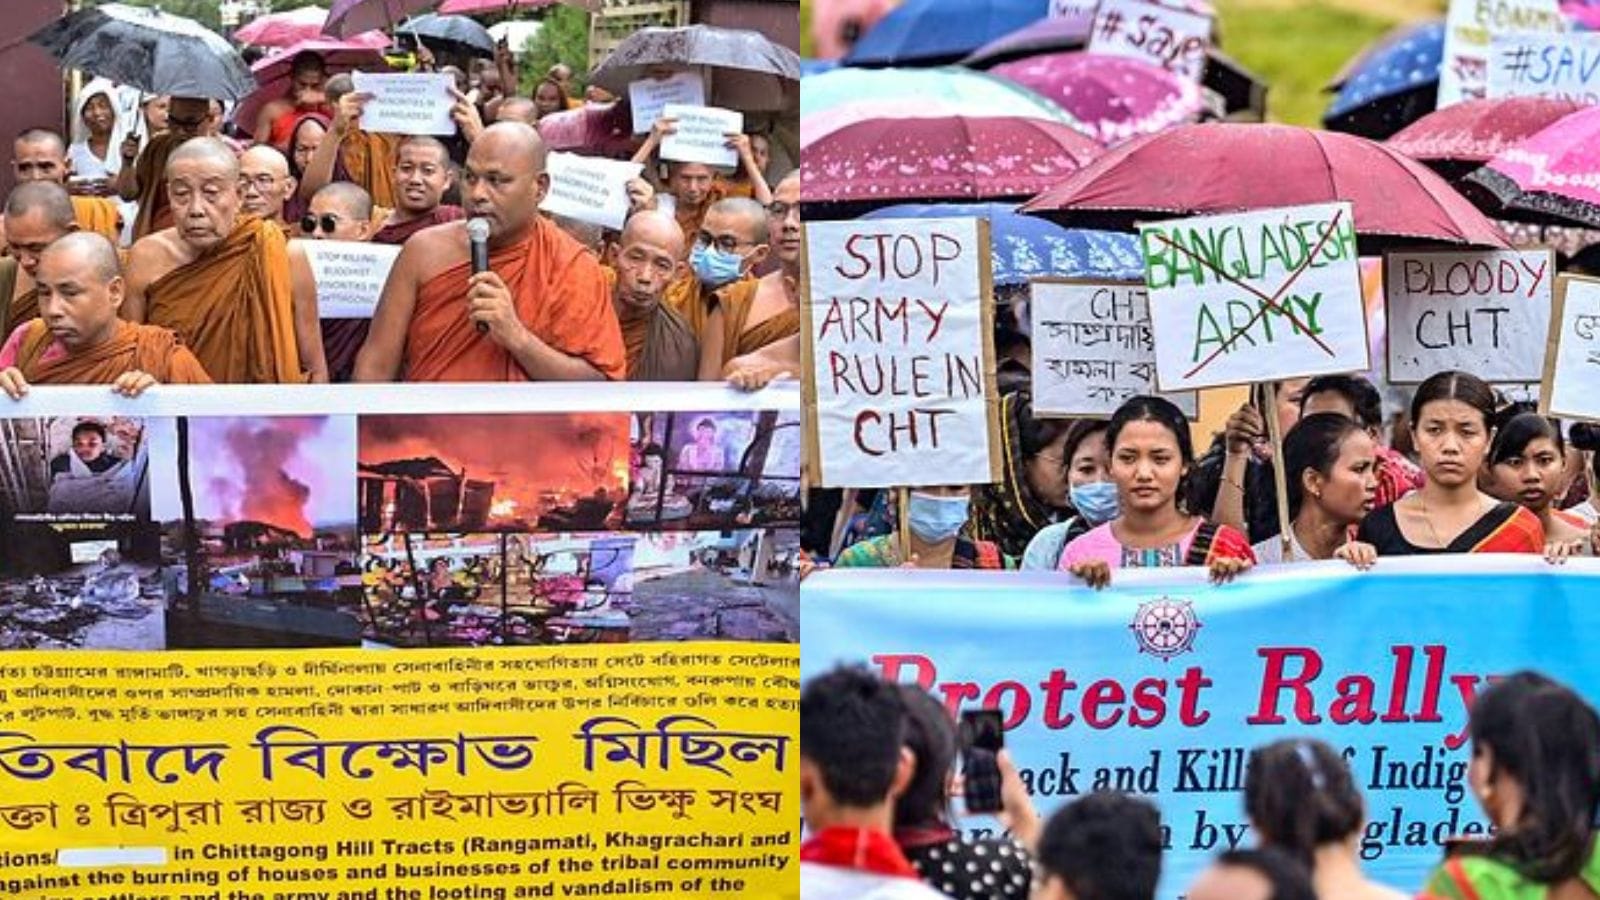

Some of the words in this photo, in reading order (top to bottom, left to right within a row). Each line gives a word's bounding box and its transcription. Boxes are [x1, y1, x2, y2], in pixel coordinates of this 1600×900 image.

[835, 233, 962, 285] STOP
[1140, 219, 1357, 290] BANGLADESH
[1404, 259, 1547, 299] BLOODY
[819, 297, 948, 343] ARMY
[1193, 293, 1325, 362] ARMY
[1416, 308, 1509, 349] CHT
[830, 351, 931, 397] RULE
[946, 352, 981, 399] IN
[854, 409, 956, 456] CHT
[250, 725, 539, 781] বিক্ষোভ
[572, 715, 791, 777] মিছিল
[1020, 753, 1080, 796] ack
[1173, 748, 1248, 792] Kill
[1368, 745, 1469, 804] Indig
[104, 792, 222, 833] ত্রিপুরা
[235, 799, 327, 826] রাজ্য
[344, 799, 373, 821] ও
[612, 780, 697, 820] ভিক্ষু
[708, 790, 784, 814] সংঘ
[1190, 810, 1250, 850] by
[87, 869, 126, 886] the
[132, 869, 220, 887] burning
[227, 866, 249, 883] of
[257, 866, 339, 883] houses
[346, 863, 387, 880] and
[395, 861, 521, 879] businesses
[528, 858, 550, 875] of
[558, 857, 594, 874] the
[601, 854, 660, 871] tribal
[667, 853, 789, 872] community
[175, 845, 194, 861] in
[202, 843, 328, 862] Chittagong
[336, 840, 374, 856] Hill
[381, 838, 455, 856] Tracts
[463, 833, 598, 856] (Rangamati,
[605, 831, 744, 851] Khagrachari
[751, 831, 791, 848] and
[336, 887, 378, 900] and
[385, 885, 422, 900] the
[430, 883, 507, 900] looting
[514, 881, 554, 898] and
[561, 878, 673, 897] vandalism
[680, 877, 703, 893] of
[711, 876, 745, 893] the
